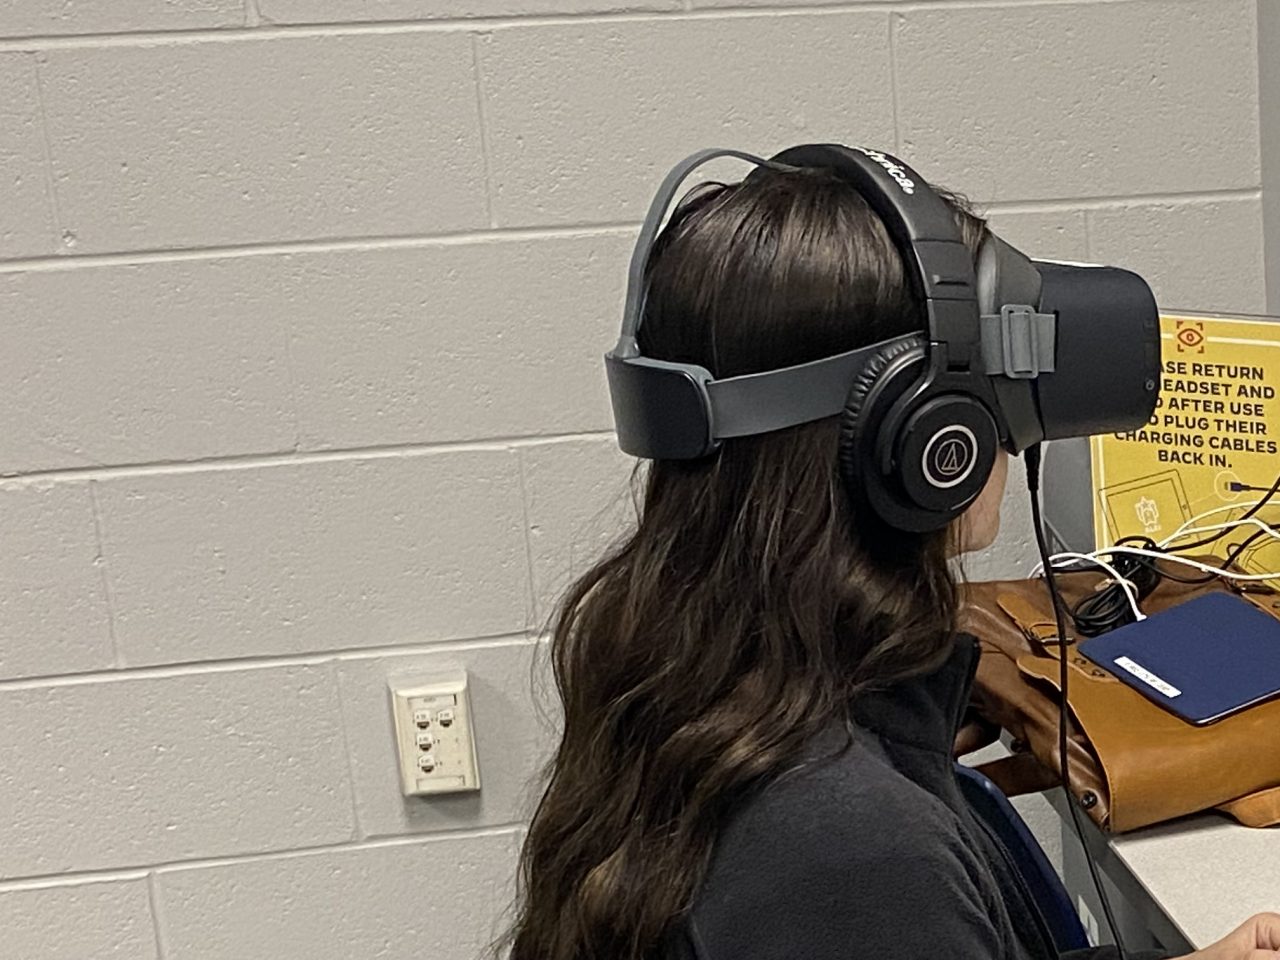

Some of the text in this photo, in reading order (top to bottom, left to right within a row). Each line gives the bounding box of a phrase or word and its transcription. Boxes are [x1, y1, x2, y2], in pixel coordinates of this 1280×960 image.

[1192, 363, 1264, 380] RETURN
[1162, 379, 1275, 399] EADSET AND
[1168, 397, 1225, 414] AFTER
[1230, 402, 1264, 417] USE
[1164, 415, 1209, 430] PLUG
[1213, 419, 1267, 435] THEIR
[1208, 436, 1277, 454] CABLES
[1158, 450, 1232, 468] BACK IN.
